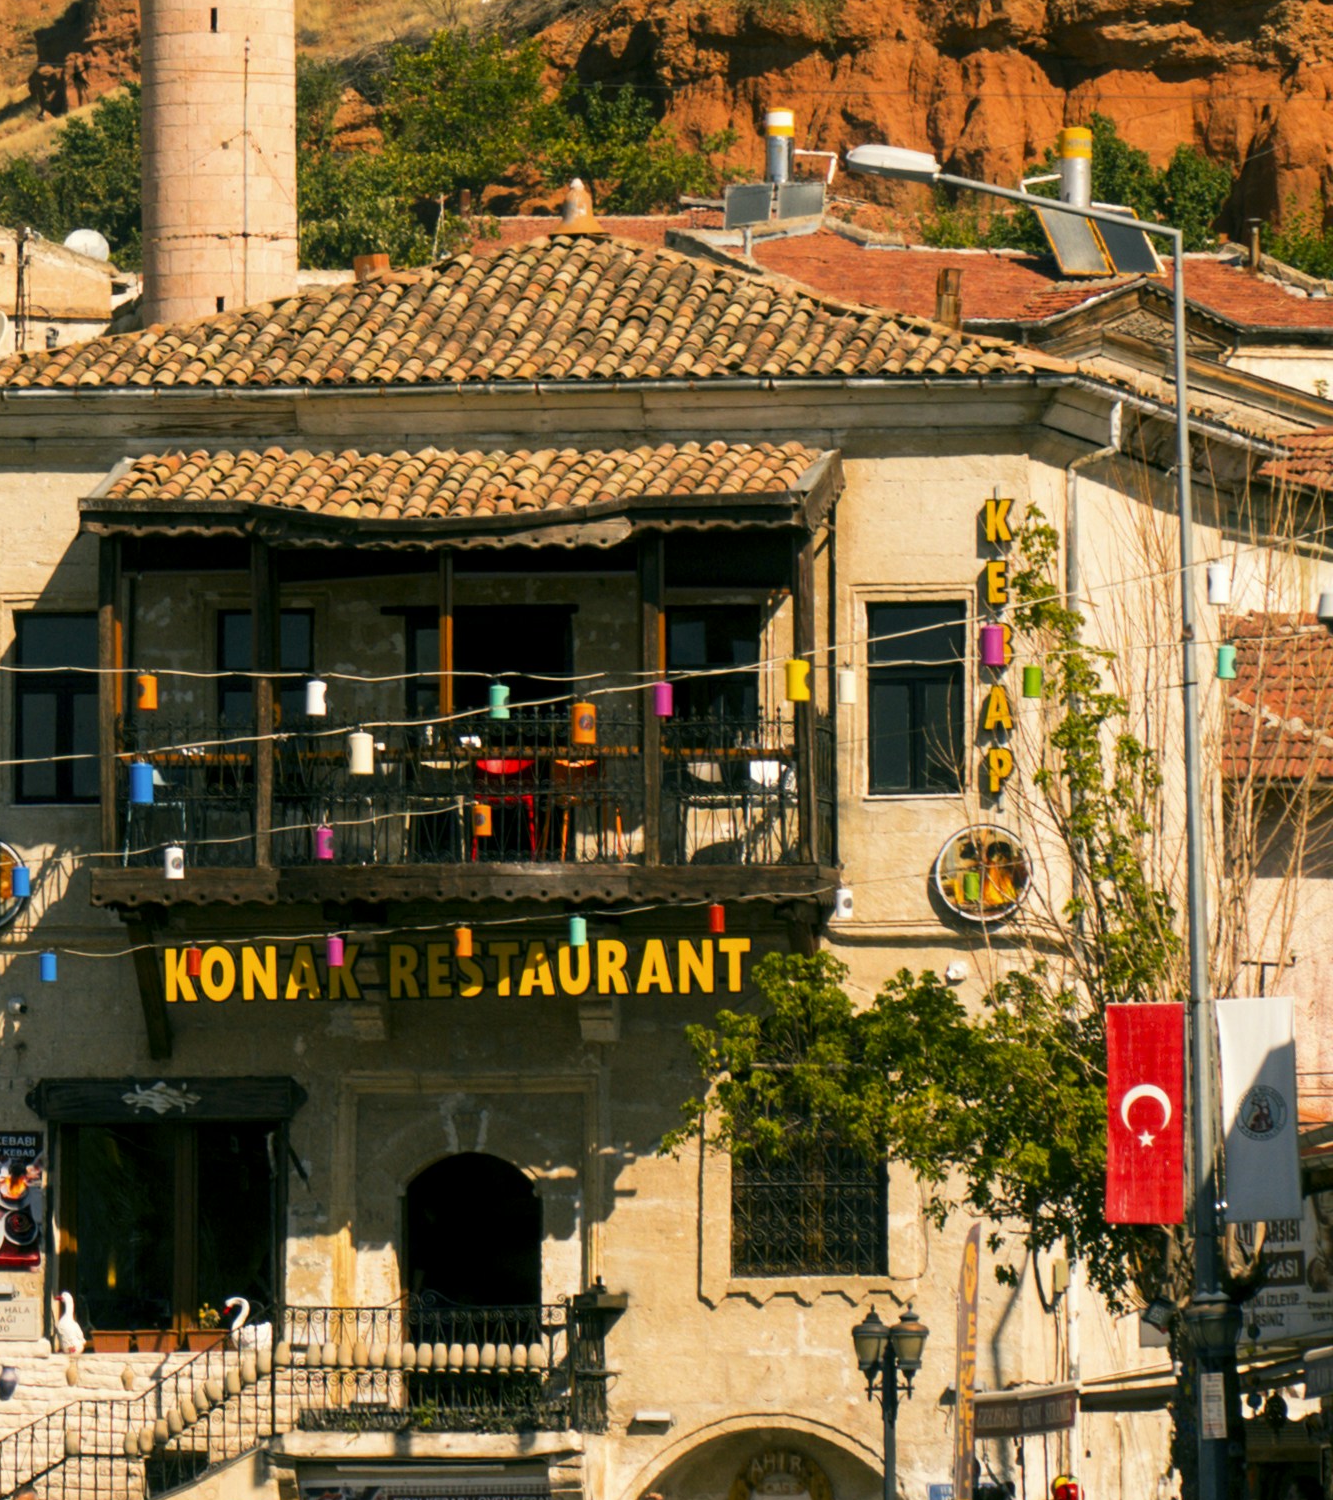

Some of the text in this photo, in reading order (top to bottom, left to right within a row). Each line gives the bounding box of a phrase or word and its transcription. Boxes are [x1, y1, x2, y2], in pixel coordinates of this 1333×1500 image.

[164, 937, 751, 1002] KONAK RESTAURANT
[4, 1306, 31, 1314] HALA
